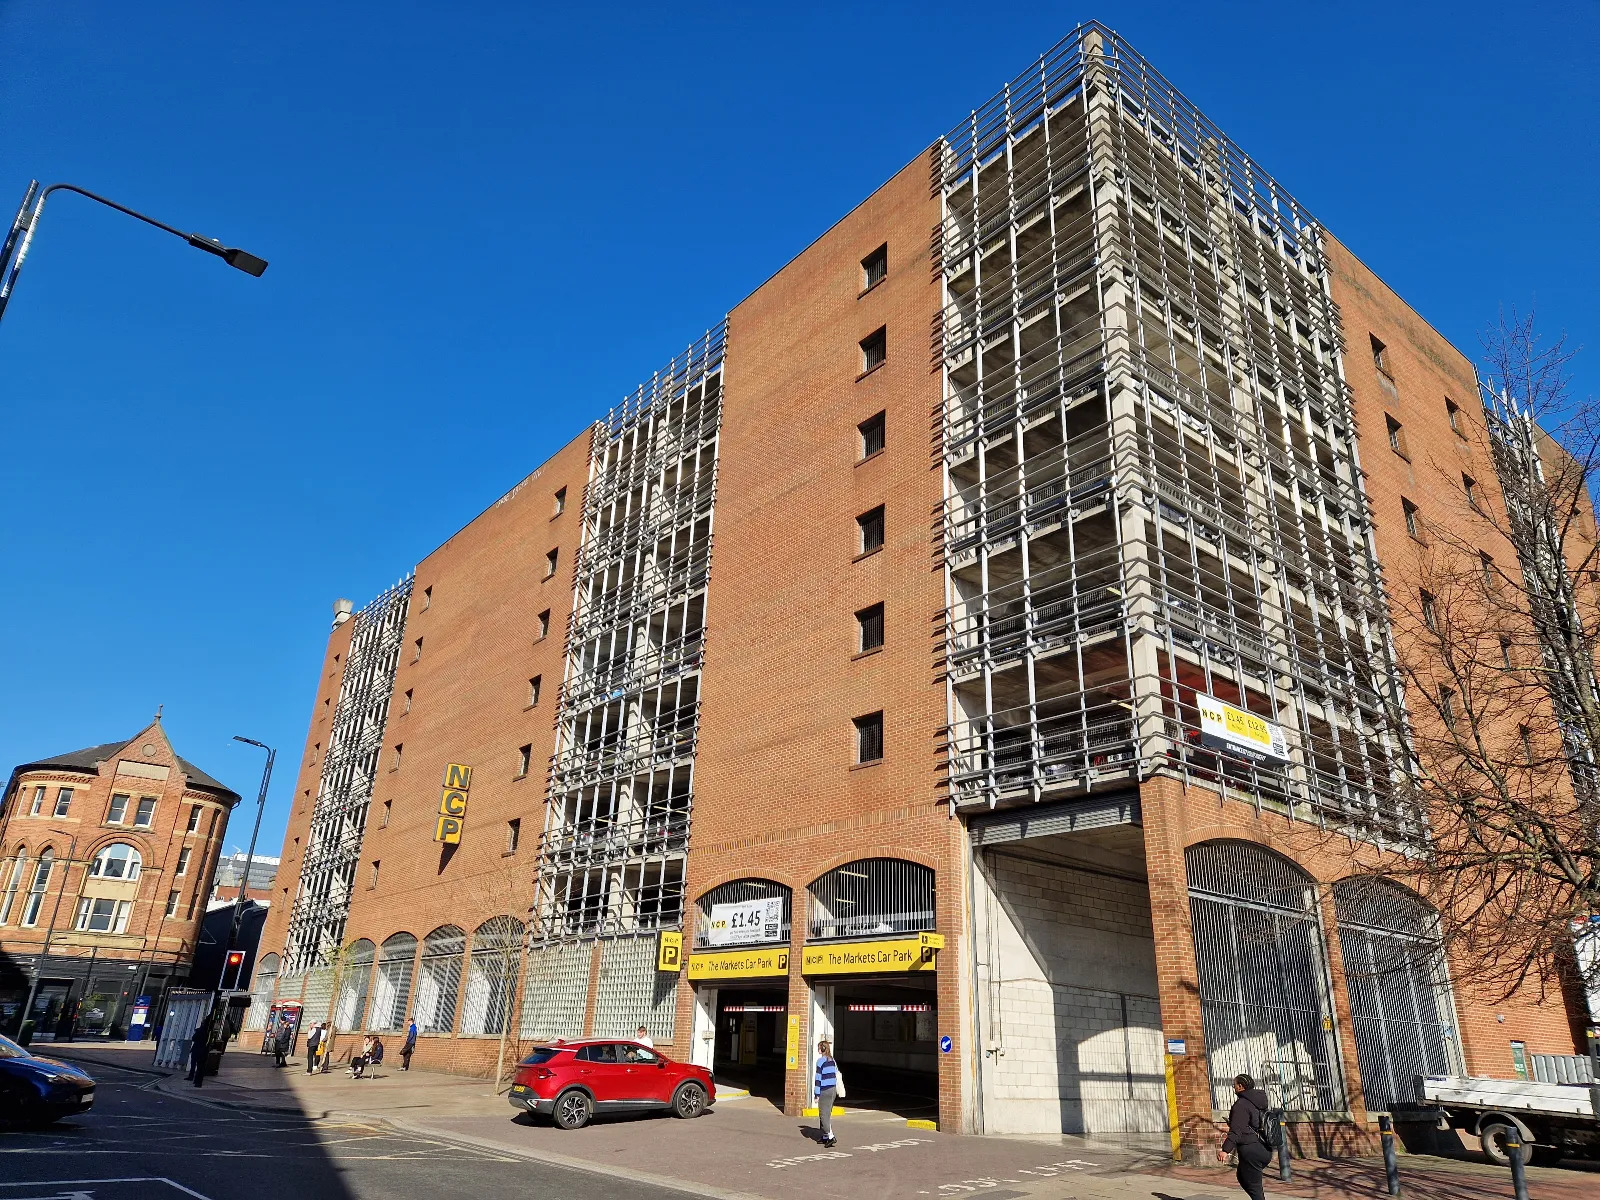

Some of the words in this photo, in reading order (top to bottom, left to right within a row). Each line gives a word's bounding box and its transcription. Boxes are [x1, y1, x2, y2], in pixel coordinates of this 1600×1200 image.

[440, 765, 470, 841] NCP
[711, 920, 726, 929] NCP
[732, 910, 761, 928] £1.45
[665, 947, 676, 964] P
[829, 953, 842, 964] The
[843, 952, 876, 964] Markets
[877, 950, 891, 962] Car
[893, 949, 913, 961] Park
[708, 961, 719, 971] The
[720, 959, 745, 971] Markets
[745, 959, 756, 970] Car
[757, 957, 773, 968] Park
